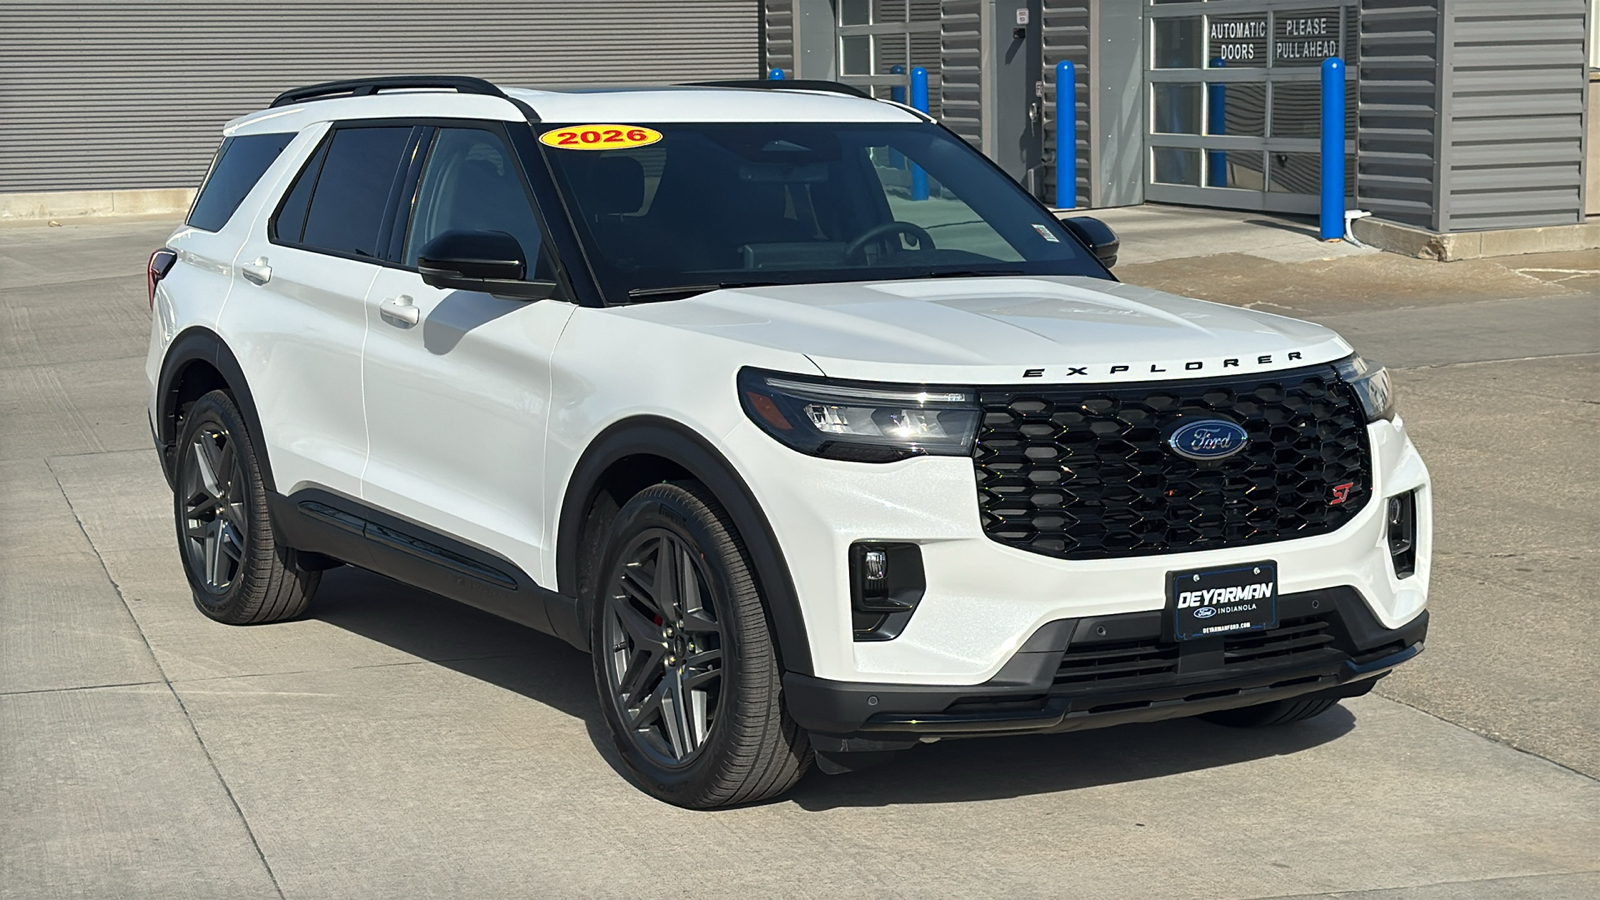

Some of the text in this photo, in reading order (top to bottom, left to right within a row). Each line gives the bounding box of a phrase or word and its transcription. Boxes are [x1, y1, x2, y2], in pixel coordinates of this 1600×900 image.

[1211, 21, 1266, 38] AUTOMATIC
[1286, 18, 1327, 35] PLEASE
[1221, 44, 1254, 59] DOORS
[1277, 40, 1336, 58] PULL AHEAD
[557, 129, 648, 145] 2026
[1022, 351, 1303, 378] EXPLORER
[1191, 428, 1232, 449] Ford
[1329, 482, 1354, 505] ST
[1177, 582, 1273, 609] DEYARMAN
[1217, 603, 1257, 614] INDIANOLA
[1202, 621, 1251, 634] DEYARMANFORD.COM
